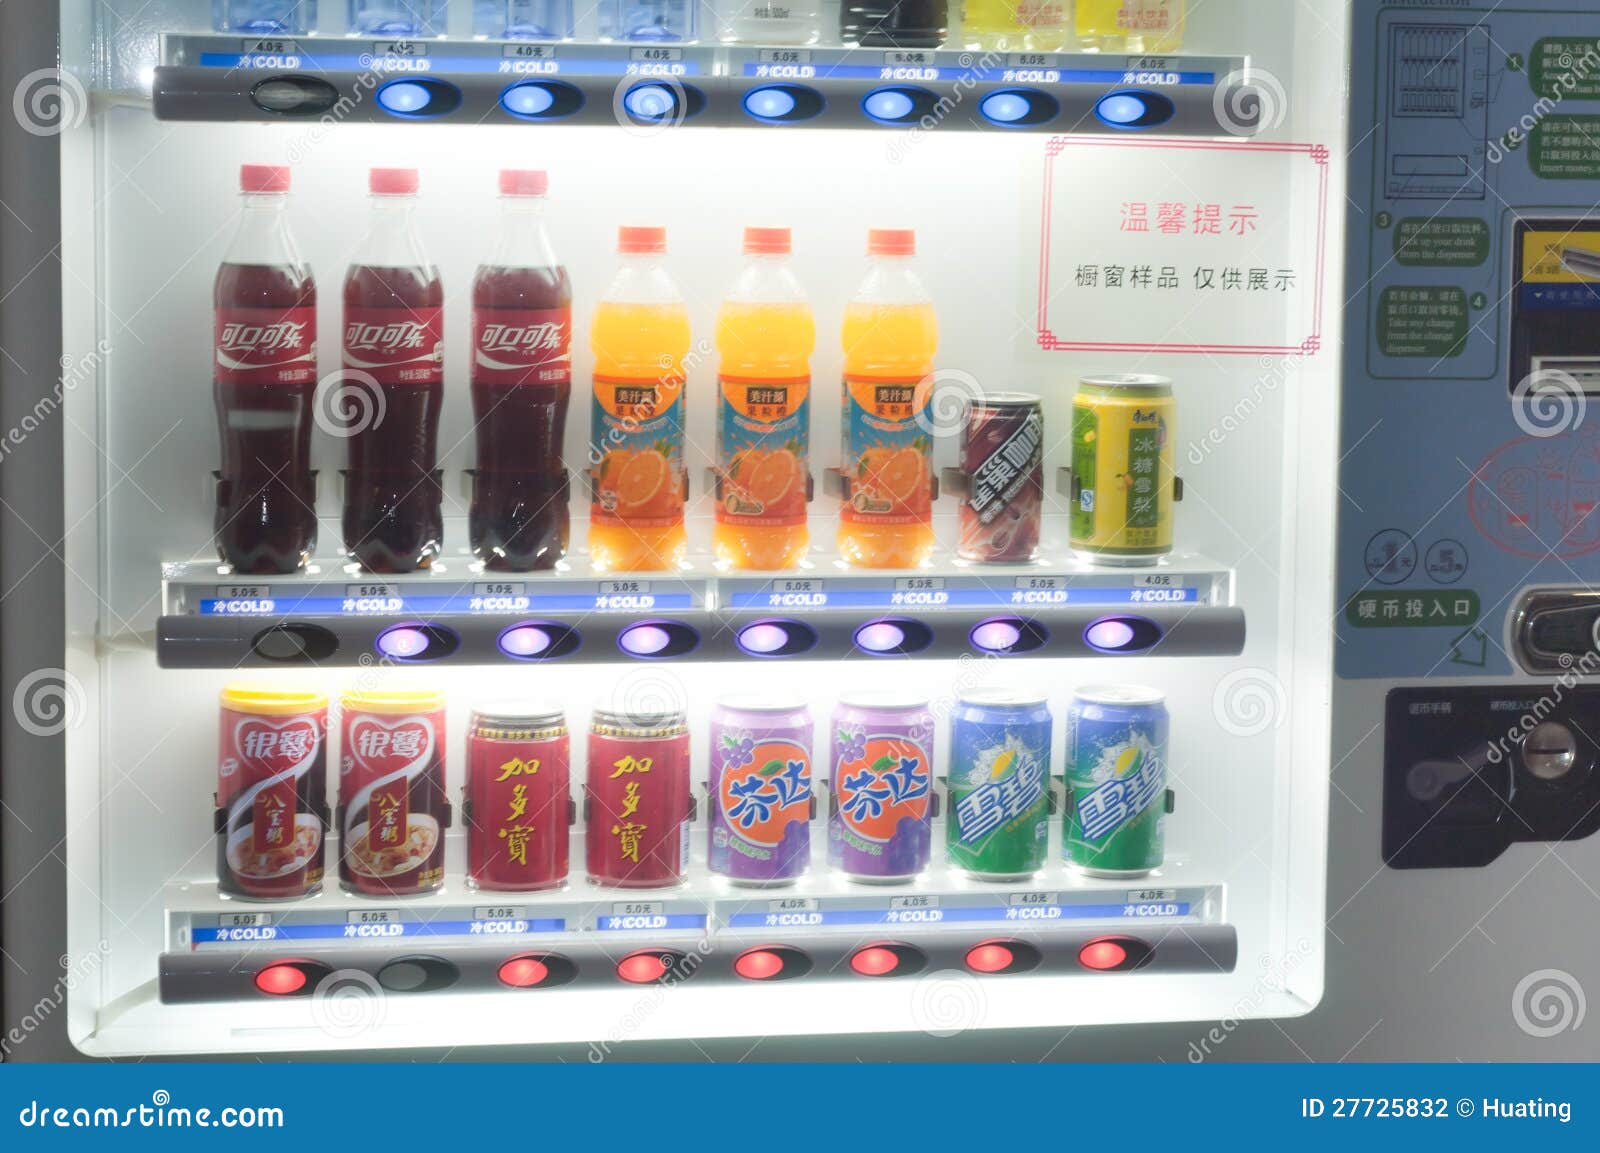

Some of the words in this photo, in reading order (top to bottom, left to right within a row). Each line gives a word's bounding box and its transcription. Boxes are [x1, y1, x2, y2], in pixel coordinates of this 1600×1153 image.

[516, 46, 543, 57] 4.0元
[644, 49, 670, 60] 4.0元
[772, 52, 799, 62] 5.0元
[1120, 202, 1258, 235] 温馨提示
[1379, 214, 1388, 226] 3
[1075, 264, 1179, 290] 橱窗样品
[1193, 266, 1297, 292] 仅供展示
[1473, 296, 1482, 307] 4
[221, 321, 308, 349] 可口可乐
[347, 321, 428, 349] 可口可乐
[481, 322, 565, 350] 可口可乐
[750, 389, 786, 403] 美汁源
[1133, 436, 1154, 513] 冰糖雪梨
[785, 581, 811, 591] 5.0元
[907, 579, 933, 589] 5.0元
[1030, 578, 1055, 589] 5.0元
[1145, 575, 1170, 586] 4.0元
[231, 587, 258, 598] 5.0元
[360, 586, 387, 596] 5.0元
[487, 584, 513, 594] 5.0元
[1359, 598, 1471, 619] 硬币投入口
[245, 729, 312, 759] 银鹭
[359, 729, 422, 758] 银鹭
[727, 760, 811, 828] 芬达
[843, 758, 928, 822] 芬达
[957, 756, 1042, 842] 雪碧
[1021, 893, 1047, 903] 4.0元
[1139, 890, 1165, 900] 4.0元
[780, 899, 806, 909] 4.0元
[902, 897, 927, 908] 4.0元
[488, 908, 514, 919] 5.0元
[625, 904, 651, 914] 5.0元
[362, 912, 388, 923] 5.0元
